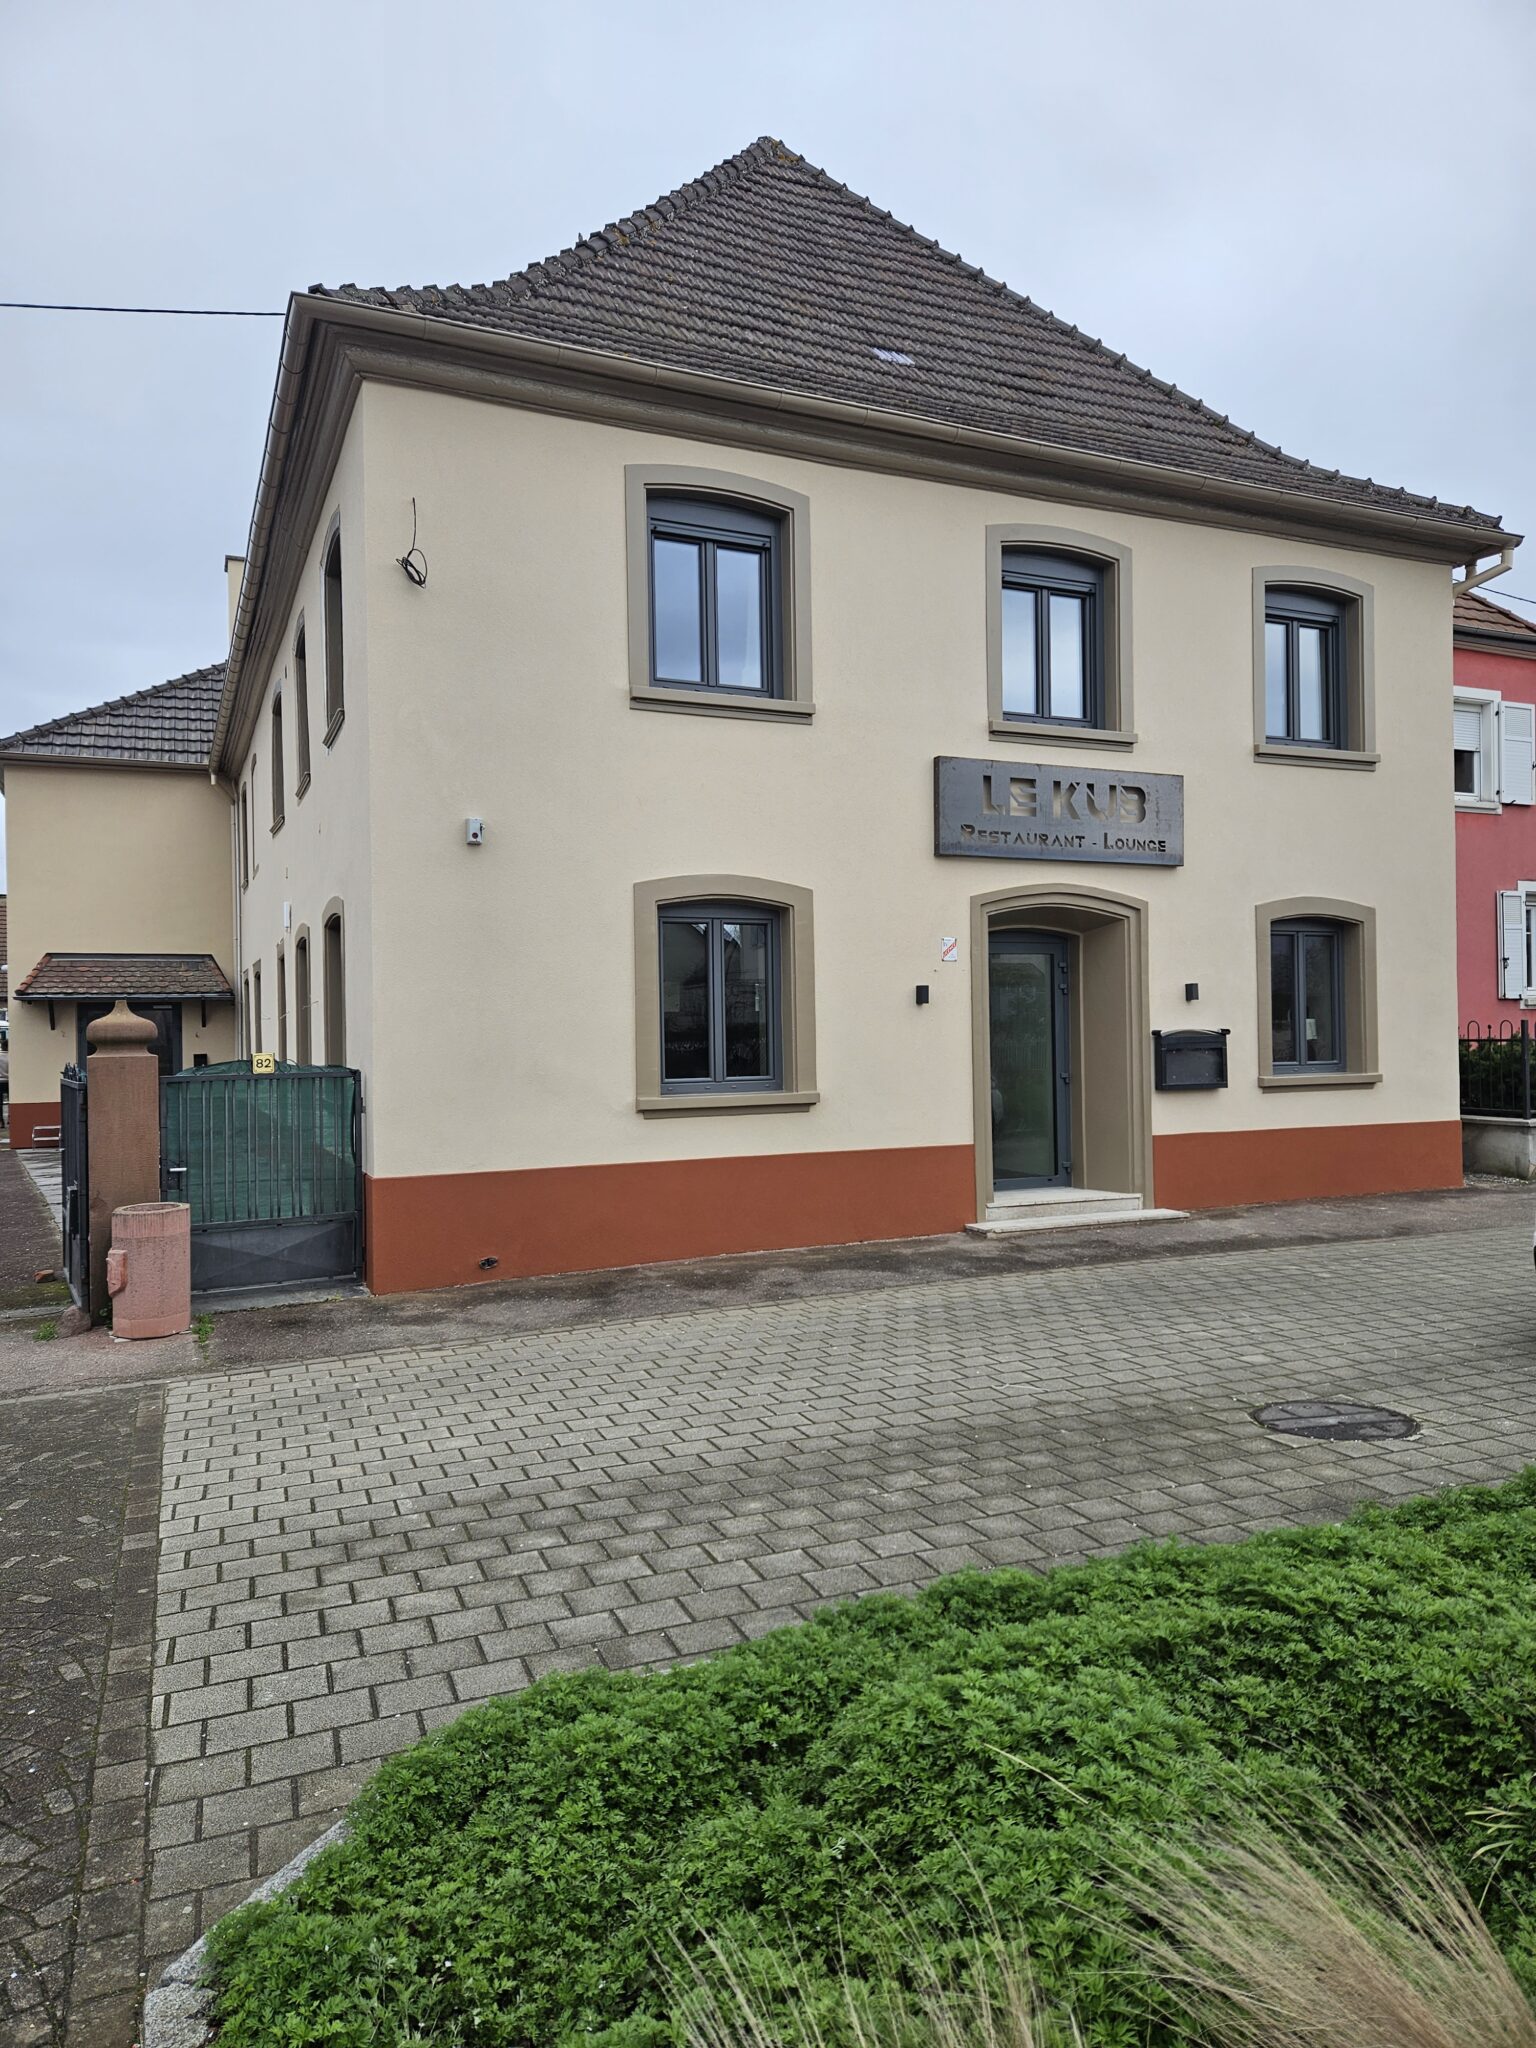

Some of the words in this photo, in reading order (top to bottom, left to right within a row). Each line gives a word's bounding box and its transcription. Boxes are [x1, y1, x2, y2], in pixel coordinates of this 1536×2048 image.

[982, 775, 1037, 817] LE
[1053, 780, 1146, 823] KUB
[256, 1058, 271, 1068] 82
